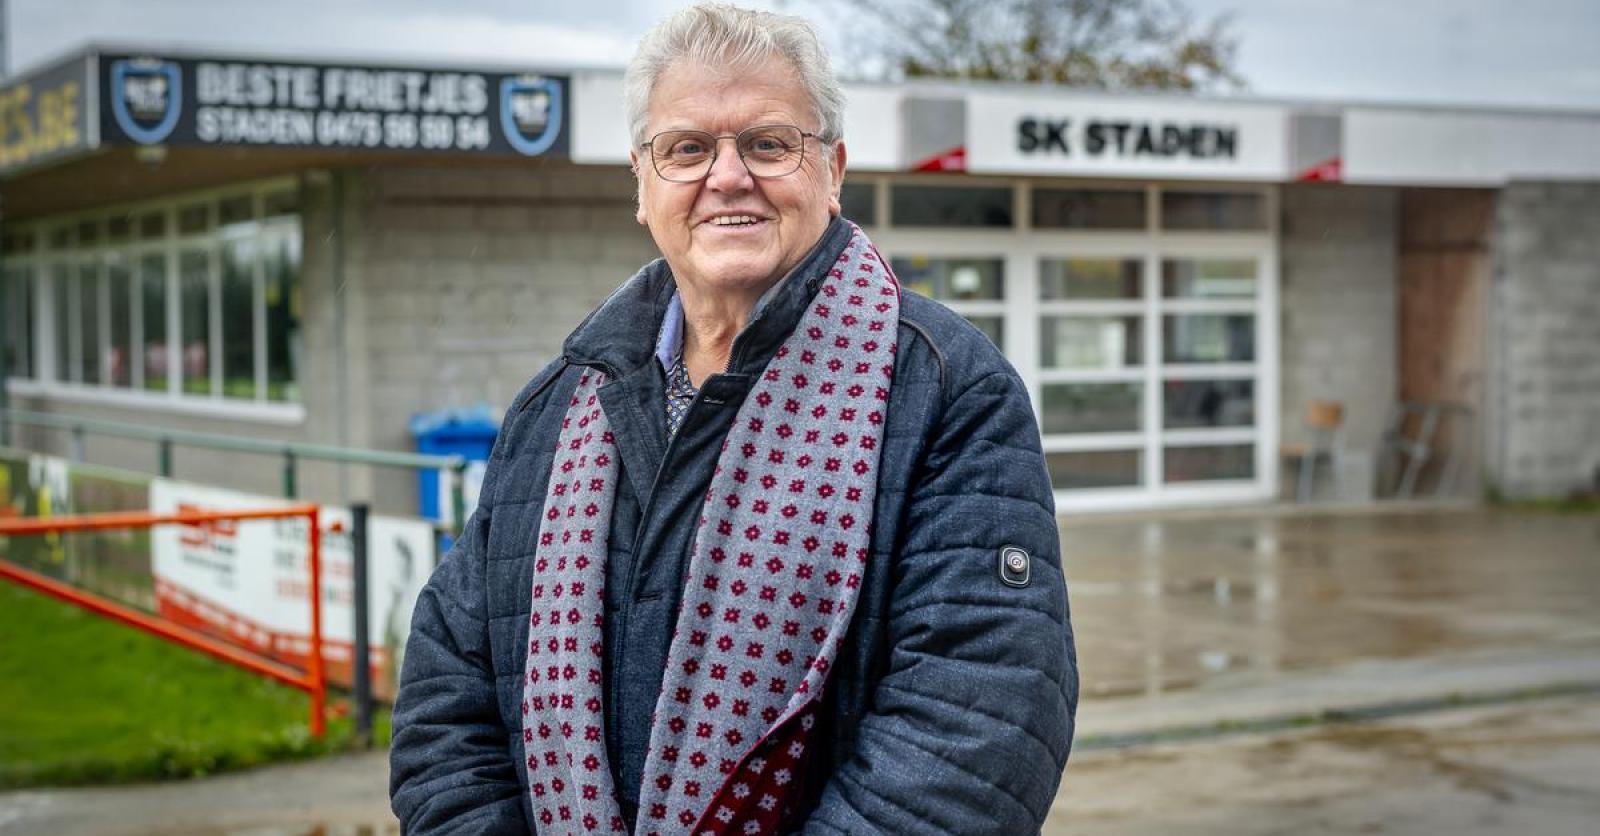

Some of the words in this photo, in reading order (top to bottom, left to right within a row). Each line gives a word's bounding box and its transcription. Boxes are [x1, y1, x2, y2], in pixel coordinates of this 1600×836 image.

[196, 61, 319, 108] BESTE
[323, 66, 488, 115] FRIETJES
[196, 106, 315, 144] STADEN
[316, 110, 382, 146] 0475
[1018, 117, 1070, 155] SK
[1085, 119, 1237, 160] STADEN
